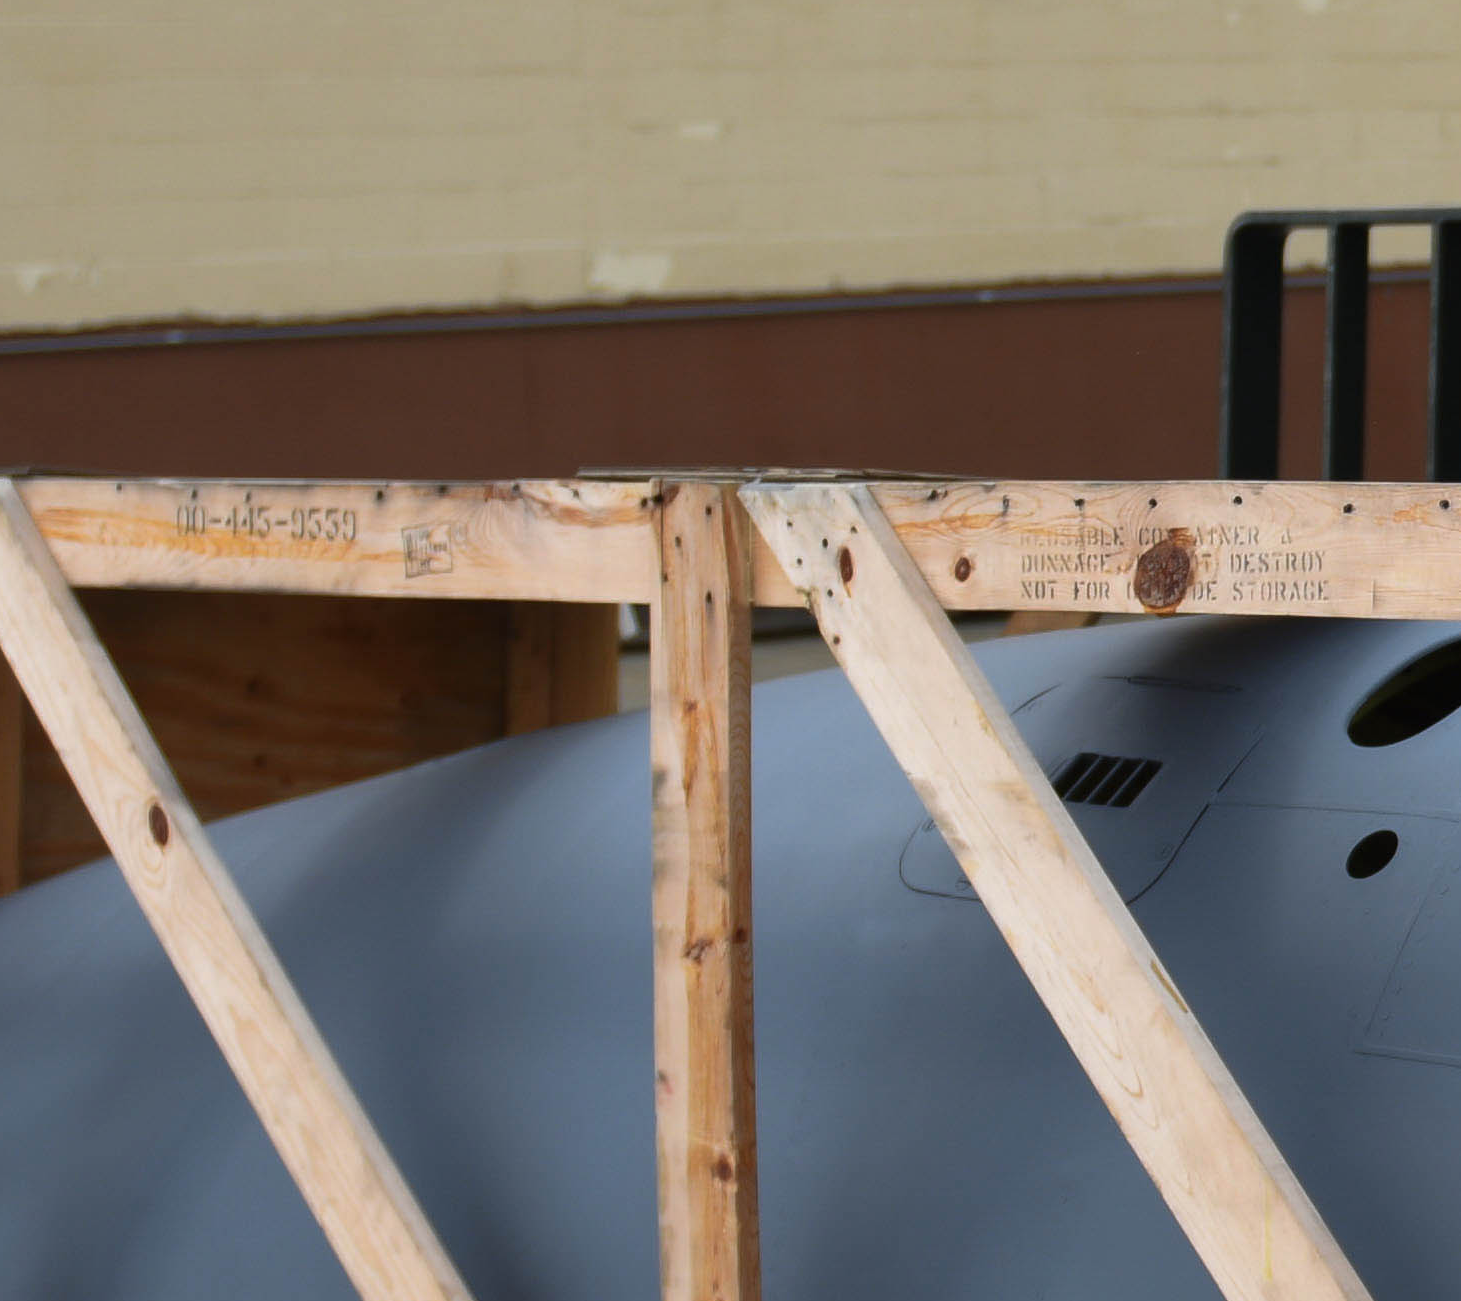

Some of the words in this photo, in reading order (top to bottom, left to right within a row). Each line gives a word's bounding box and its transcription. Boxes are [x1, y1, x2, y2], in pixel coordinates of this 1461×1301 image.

[1138, 526, 1261, 548] COAINER
[1230, 552, 1327, 575] DESTROY
[1020, 580, 1059, 601] NOT
[1073, 580, 1111, 601] FOR
[1232, 580, 1330, 602] STORAGE
